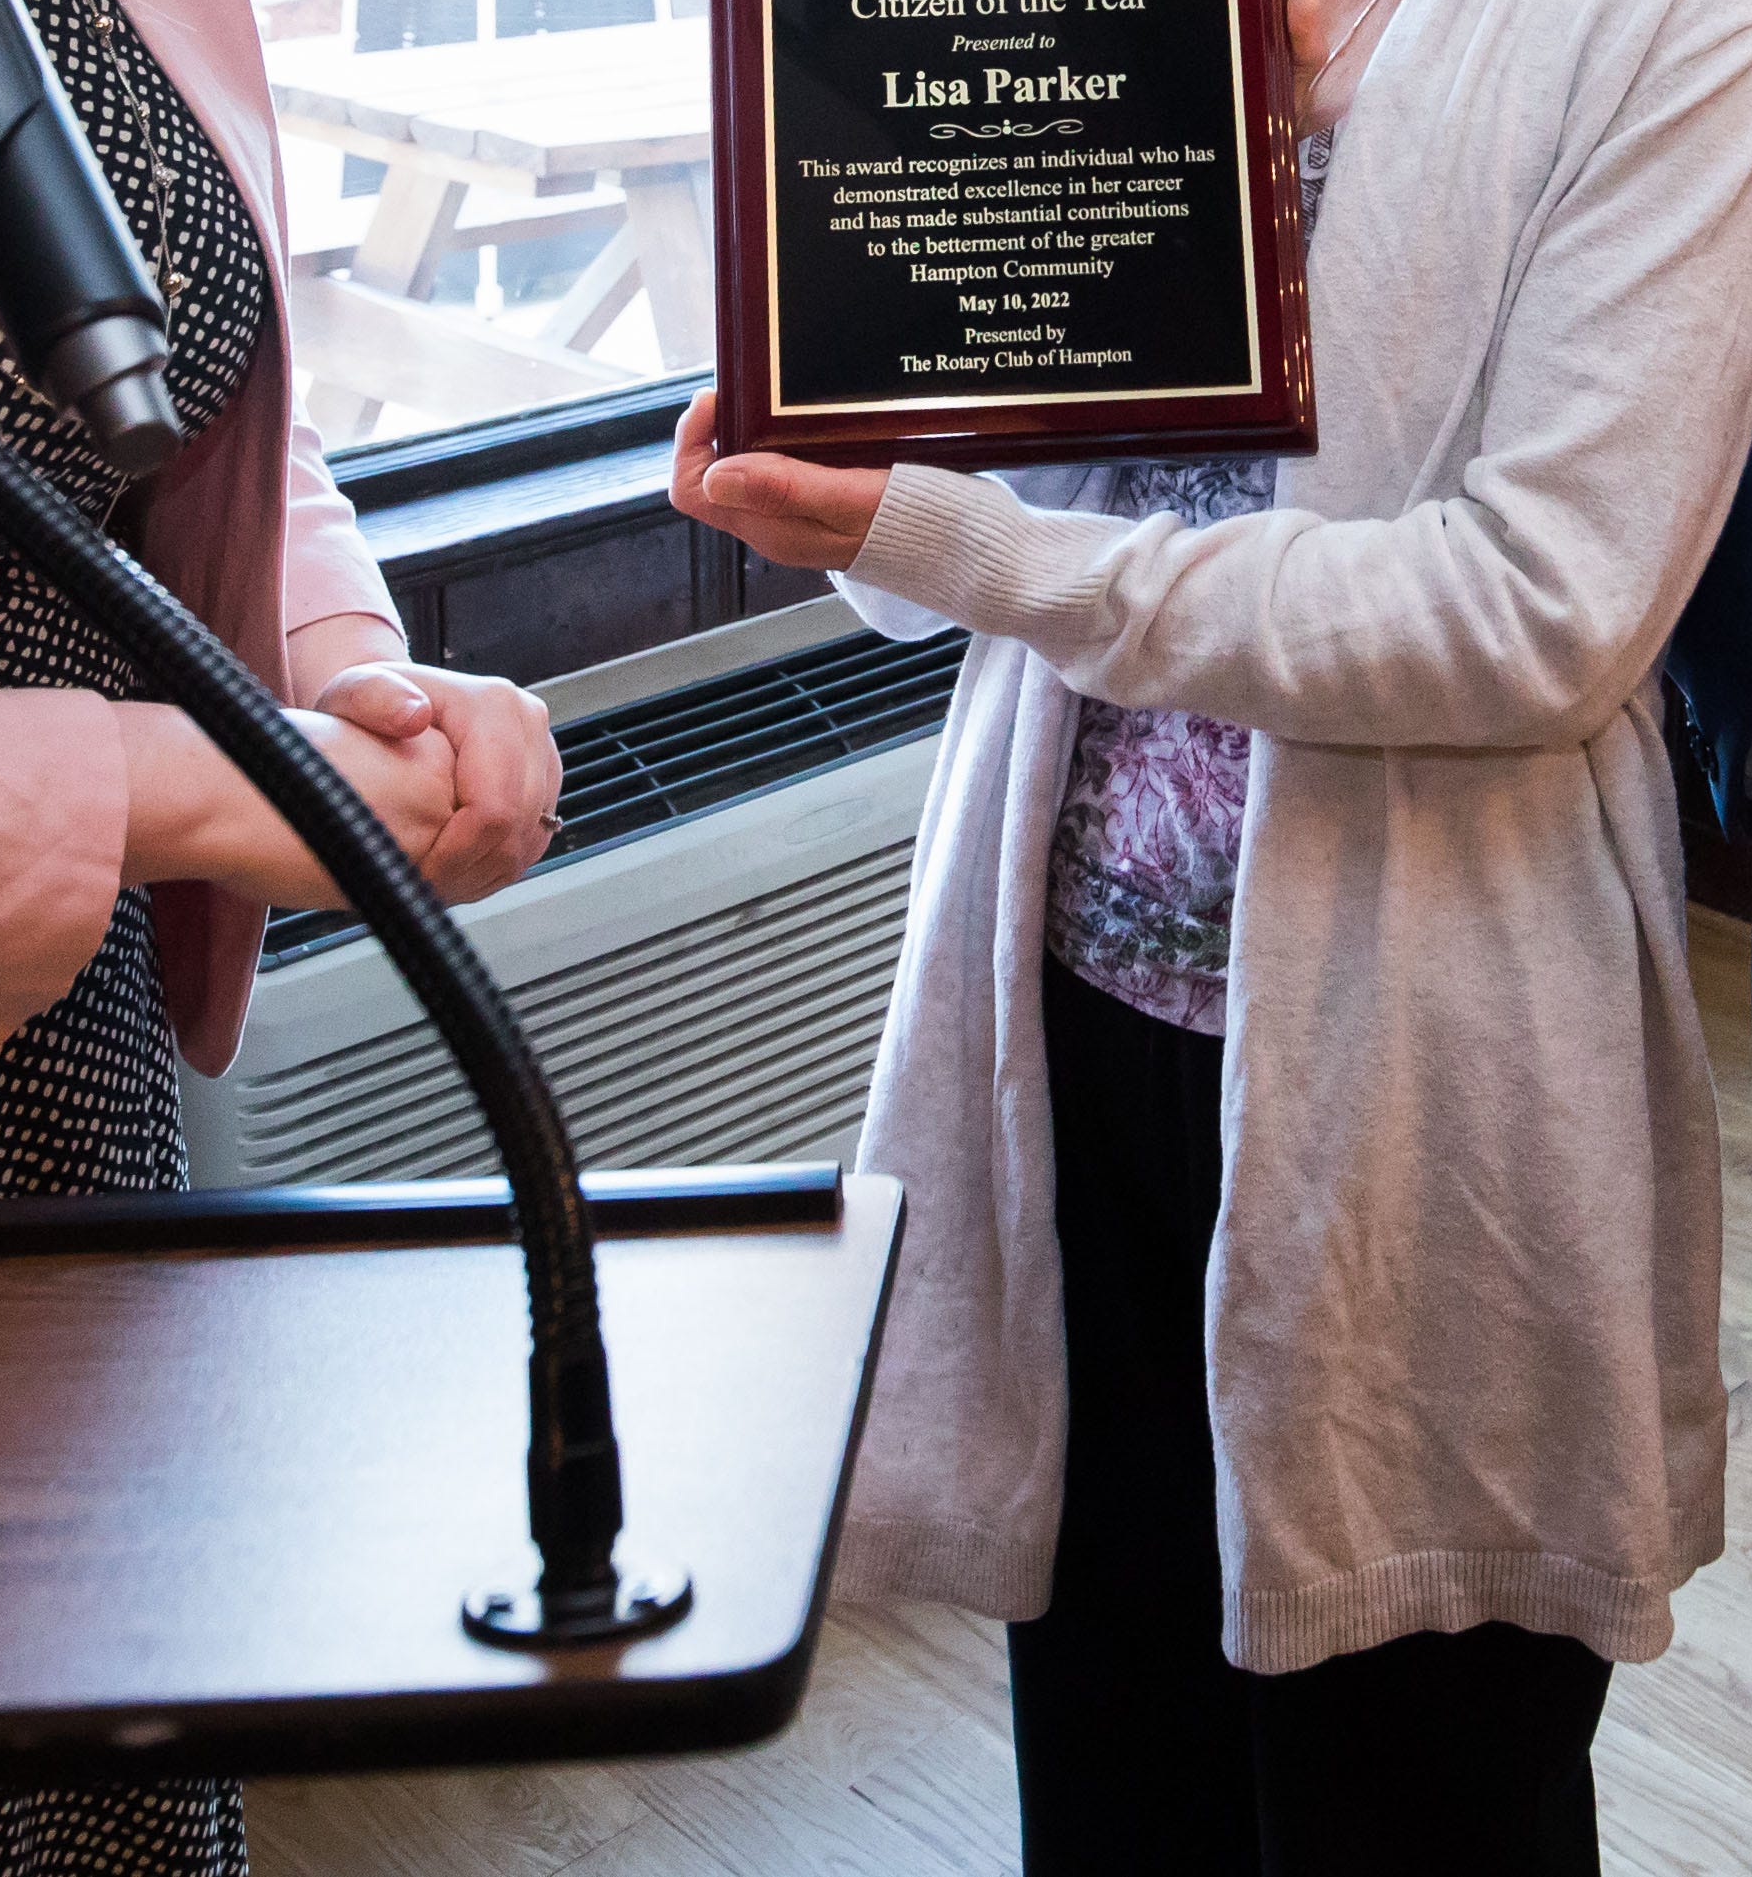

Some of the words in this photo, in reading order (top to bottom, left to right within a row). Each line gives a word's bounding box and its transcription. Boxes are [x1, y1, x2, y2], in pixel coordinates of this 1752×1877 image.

[951, 32, 1036, 52] Presented
[1039, 35, 1056, 49] to
[881, 70, 971, 108] Lisa
[982, 65, 1127, 104] Parker
[798, 158, 841, 178] This
[845, 155, 904, 176] award
[908, 152, 1008, 177] recognizes
[1013, 155, 1035, 170] an
[1041, 147, 1134, 168] individual
[1139, 146, 1180, 164] who
[1184, 144, 1216, 163] has
[833, 181, 960, 205] demonstrated
[964, 179, 1063, 200] excellence
[1068, 177, 1086, 195] in
[1091, 176, 1122, 194] her
[1126, 178, 1184, 193] career
[829, 211, 864, 231] and
[869, 211, 902, 229] has
[906, 208, 958, 228] made
[962, 203, 1062, 226] substantial
[1067, 199, 1190, 221] contributions
[867, 241, 886, 257] to
[890, 237, 921, 256] the
[924, 235, 1026, 255] betterment
[1031, 230, 1054, 250] of
[1055, 230, 1085, 249] the
[1090, 230, 1156, 252] greater
[910, 263, 998, 285] Hampton
[1003, 256, 1115, 279] Community
[958, 295, 997, 315] May
[1002, 293, 1028, 312] 10,
[1031, 291, 1071, 309] 2022
[964, 324, 1042, 345] Presented
[1045, 324, 1066, 345] by
[899, 355, 932, 373] The
[935, 354, 990, 374] Rotary
[994, 350, 1034, 368] Club
[1037, 348, 1057, 366] of
[1058, 348, 1132, 368] Hampton
